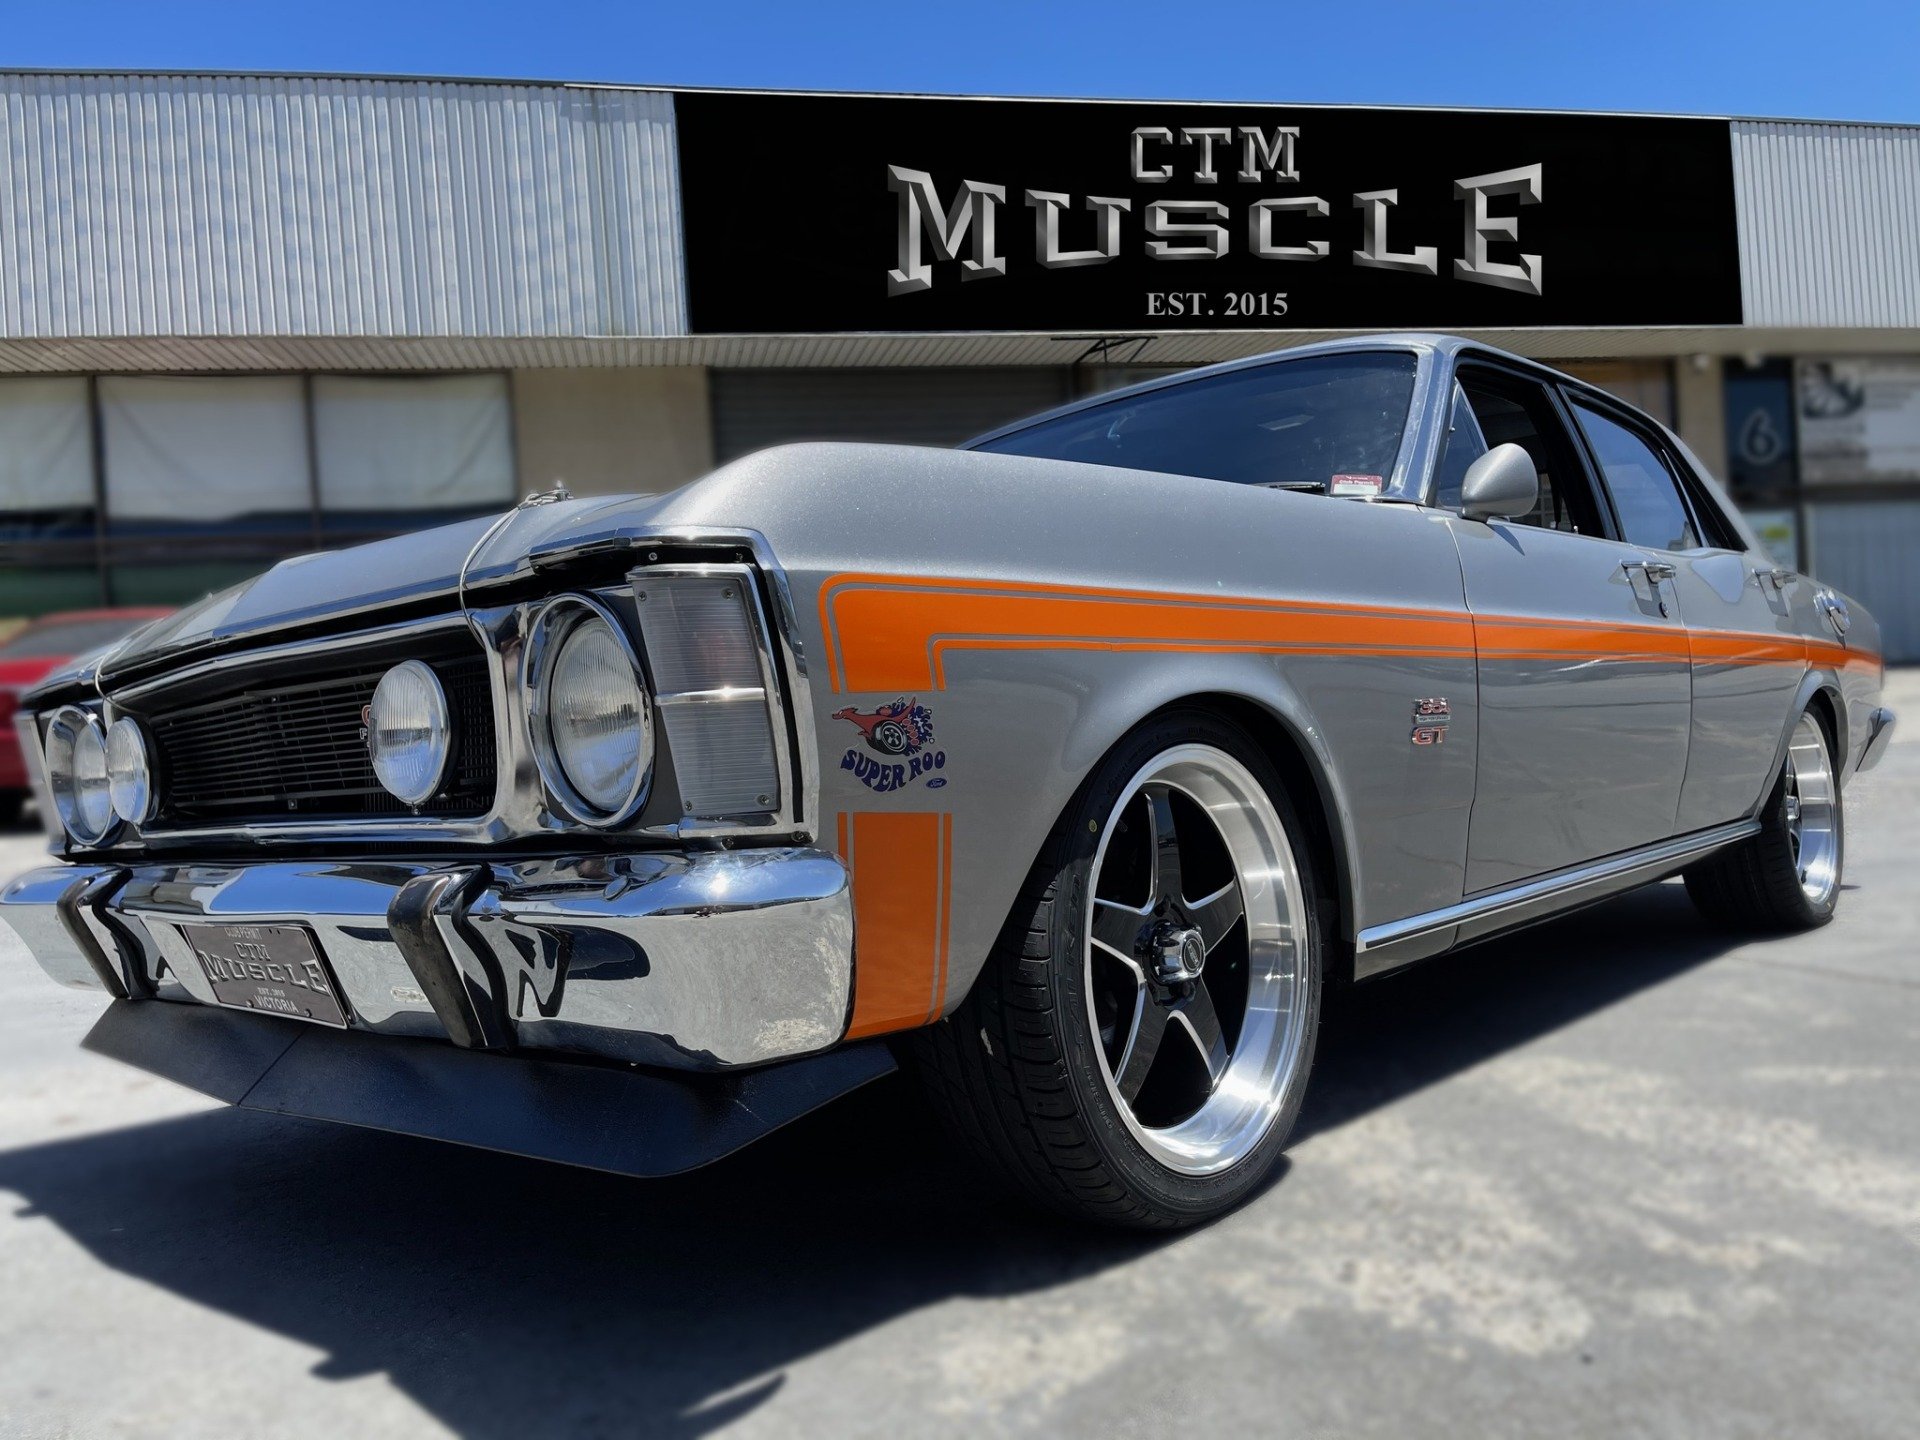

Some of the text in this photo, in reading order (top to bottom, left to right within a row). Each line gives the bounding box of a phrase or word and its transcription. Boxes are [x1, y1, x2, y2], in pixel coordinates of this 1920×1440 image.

[1130, 126, 1300, 183] CTM
[887, 162, 1543, 298] MUSCLE
[1145, 291, 1289, 317] EST. 2015
[1740, 409, 1780, 465] 6
[1412, 726, 1450, 745] GT
[840, 749, 945, 792] SUPER ROO
[197, 949, 331, 996] MUSCLE
[234, 942, 271, 961] CTM
[254, 994, 299, 1013] VICTORIA
